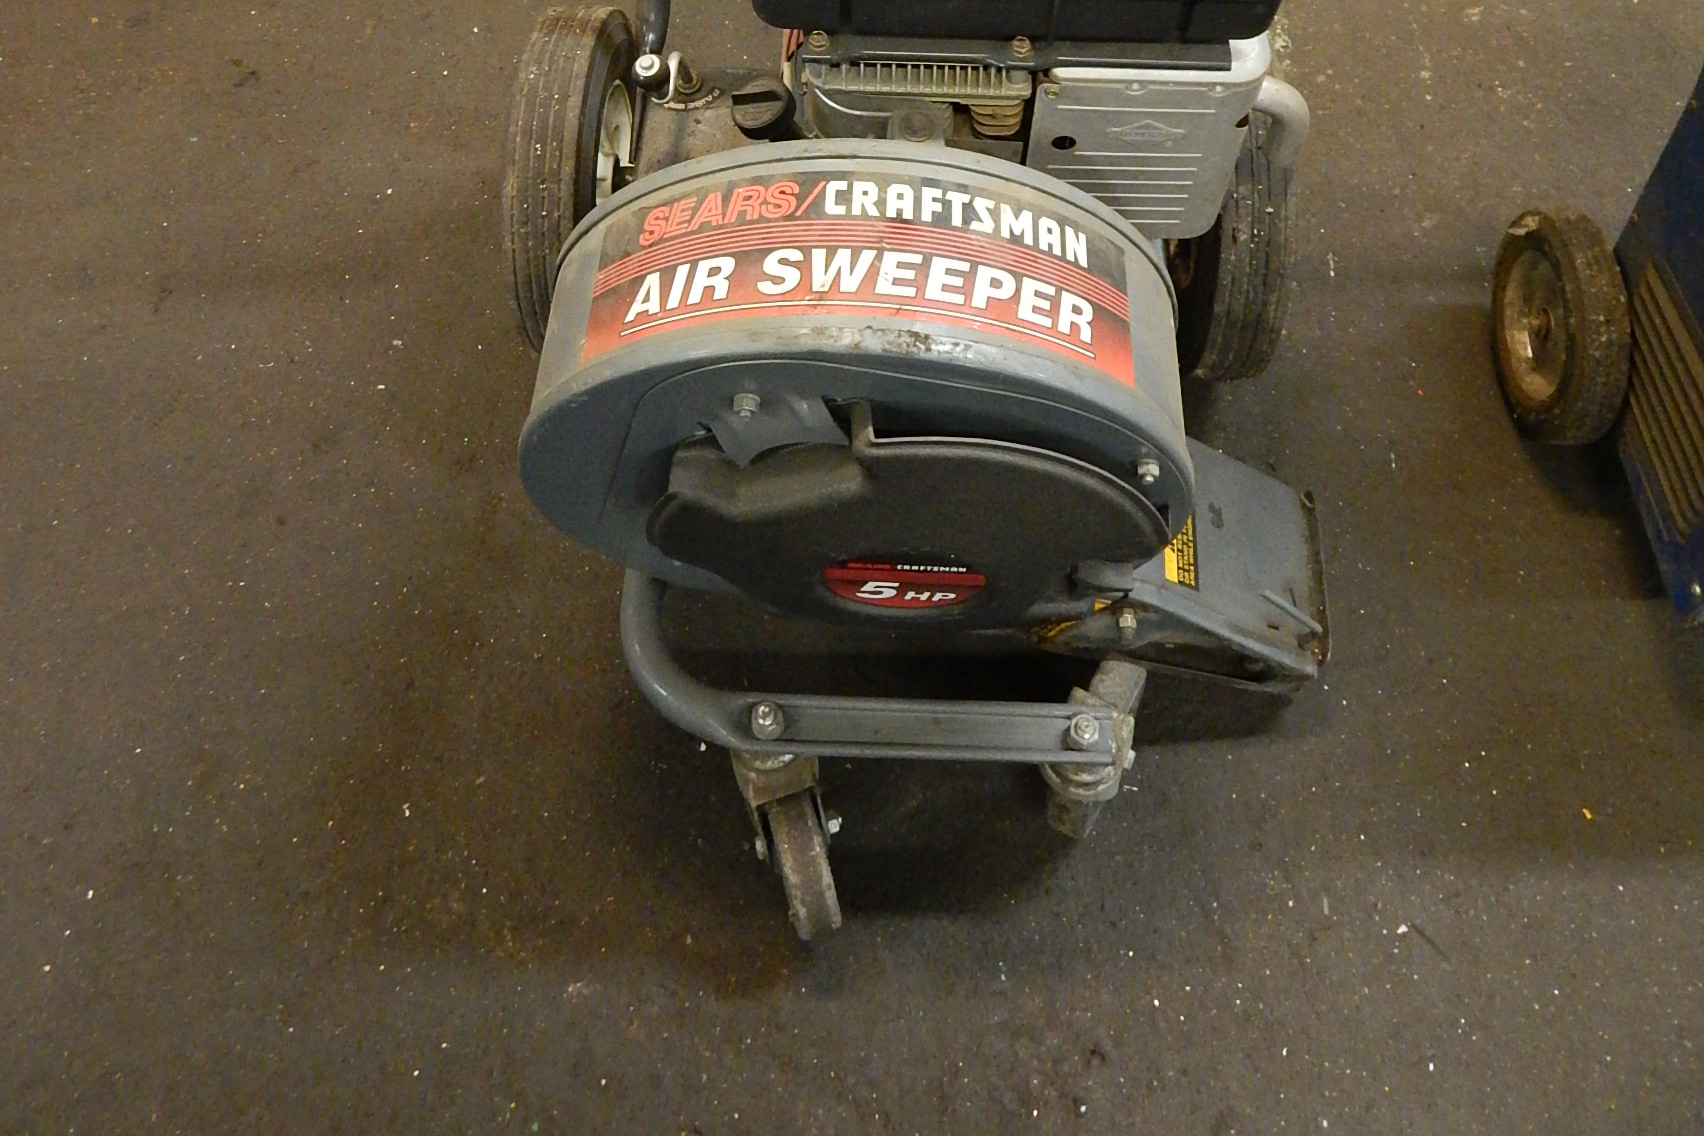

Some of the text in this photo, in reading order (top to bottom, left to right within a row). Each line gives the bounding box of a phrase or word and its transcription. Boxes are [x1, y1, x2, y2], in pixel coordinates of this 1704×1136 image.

[623, 248, 1095, 345] AIR SWEEPER
[896, 564, 967, 573] CRAFTSMAN
[856, 581, 957, 602] 5 HP
